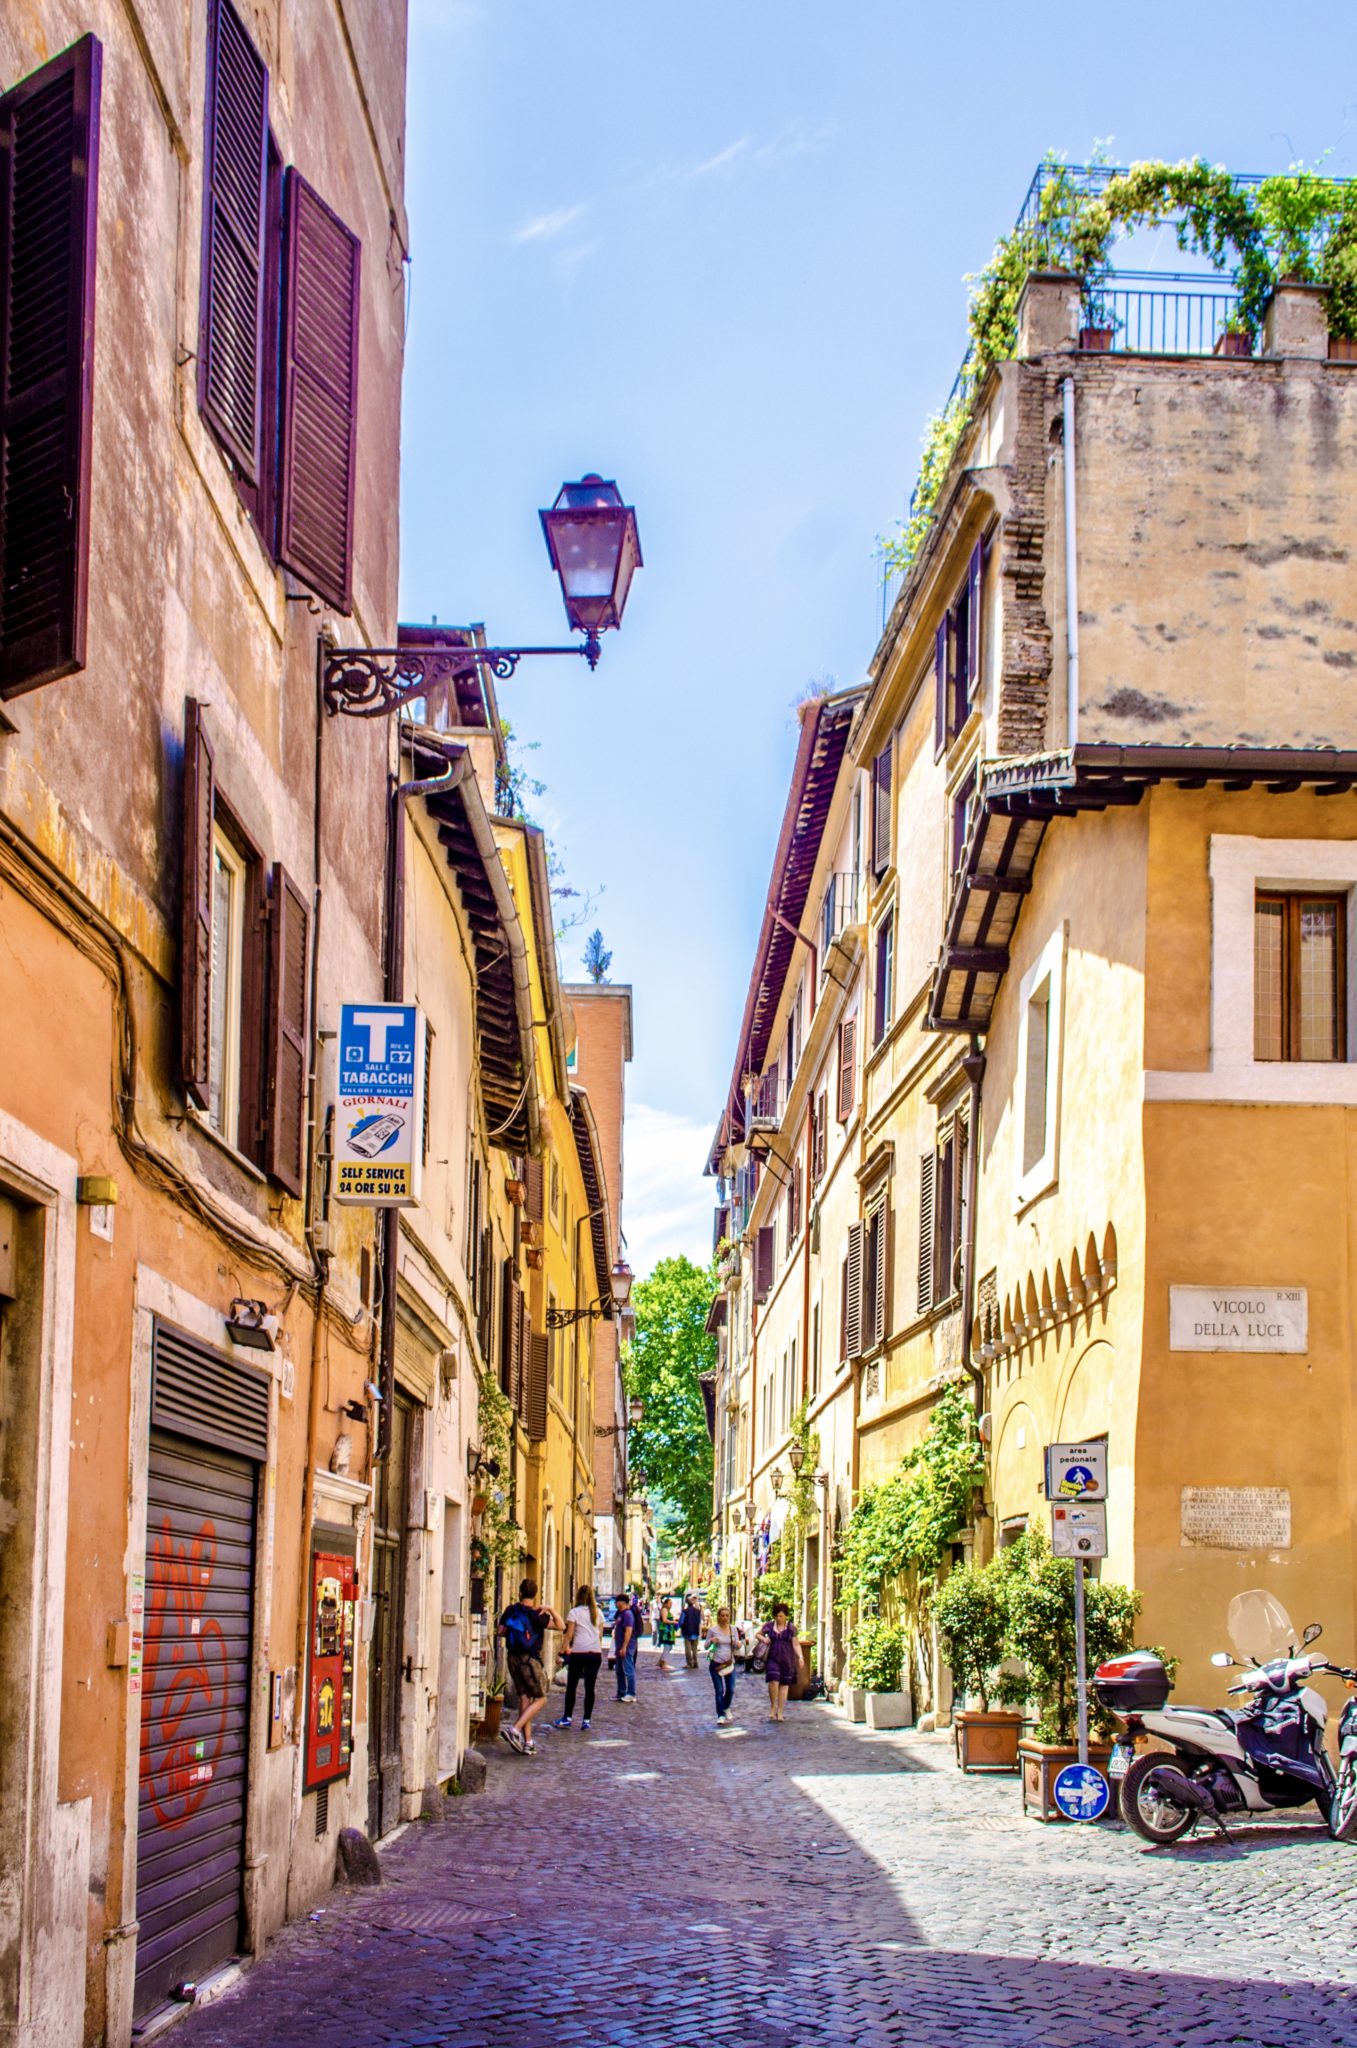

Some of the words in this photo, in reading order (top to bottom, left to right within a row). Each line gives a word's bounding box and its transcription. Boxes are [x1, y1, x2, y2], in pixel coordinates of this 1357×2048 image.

[353, 1012, 405, 1063] T
[391, 1053, 410, 1062] 27
[365, 1063, 383, 1071] SALI
[342, 1071, 413, 1085] TABACCHI
[342, 1096, 408, 1109] GIORNALI
[341, 1167, 363, 1178] SELF
[366, 1168, 405, 1179] SERVICE
[339, 1182, 352, 1193] 24
[354, 1182, 375, 1193] ORE
[378, 1183, 391, 1194] SU
[394, 1183, 406, 1194] 24
[1212, 1300, 1266, 1314] VICOLO
[1194, 1323, 1240, 1336] DELLA
[1248, 1324, 1285, 1337] LUCE
[1059, 1456, 1097, 1464] pedonale
